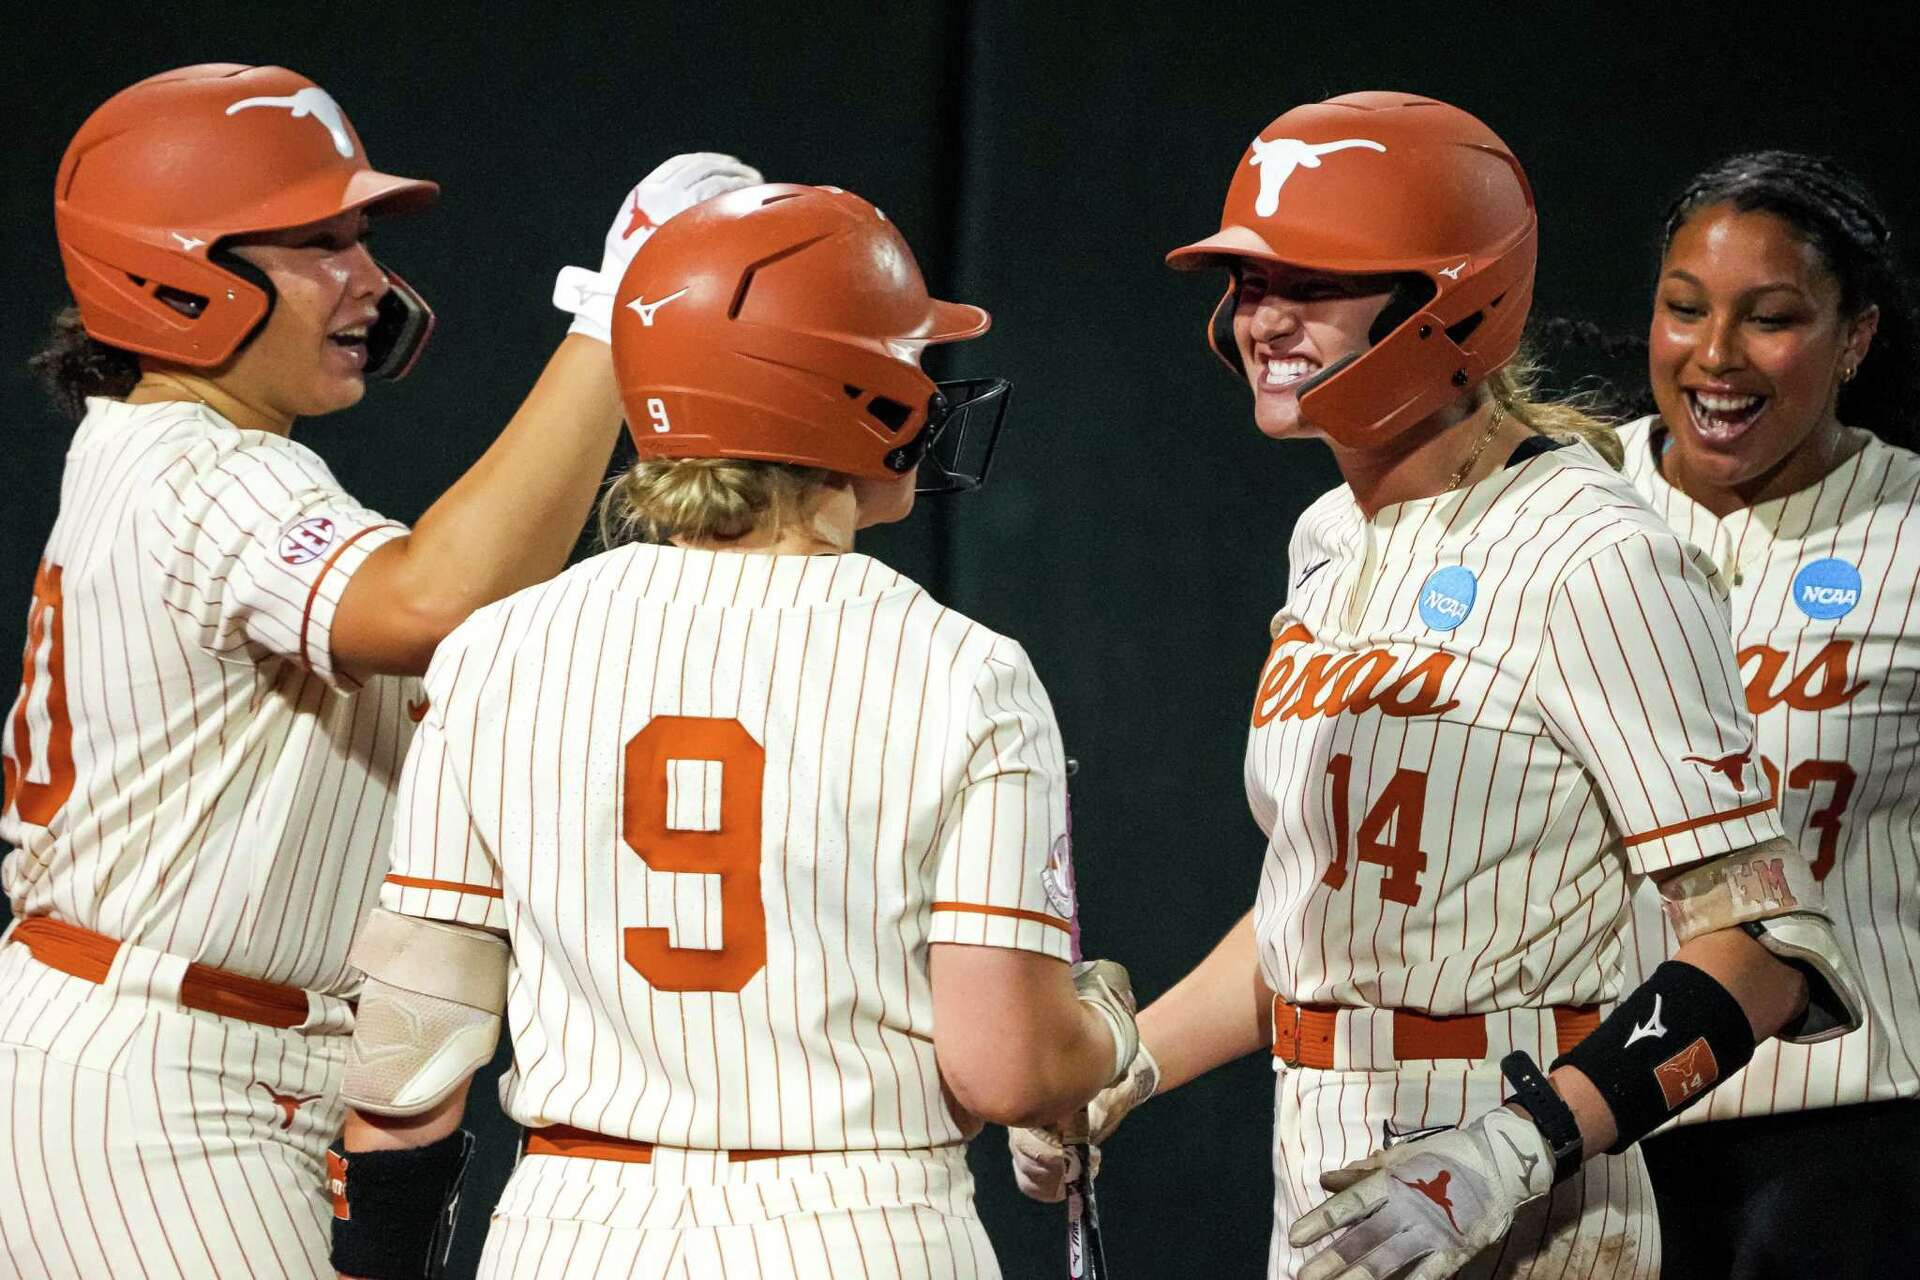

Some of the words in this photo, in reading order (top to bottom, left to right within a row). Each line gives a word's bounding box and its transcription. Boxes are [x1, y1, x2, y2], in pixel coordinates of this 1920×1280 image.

[647, 398, 671, 433] 9
[1425, 590, 1468, 620] NCAA
[1805, 585, 1857, 606] NCAA
[2, 557, 77, 828] 0
[1252, 623, 1461, 729] exas
[1736, 640, 1870, 715] as
[622, 714, 768, 993] 9
[1320, 753, 1428, 907] 14
[1760, 754, 1858, 882] 3
[1680, 1072, 1705, 1098] 14
